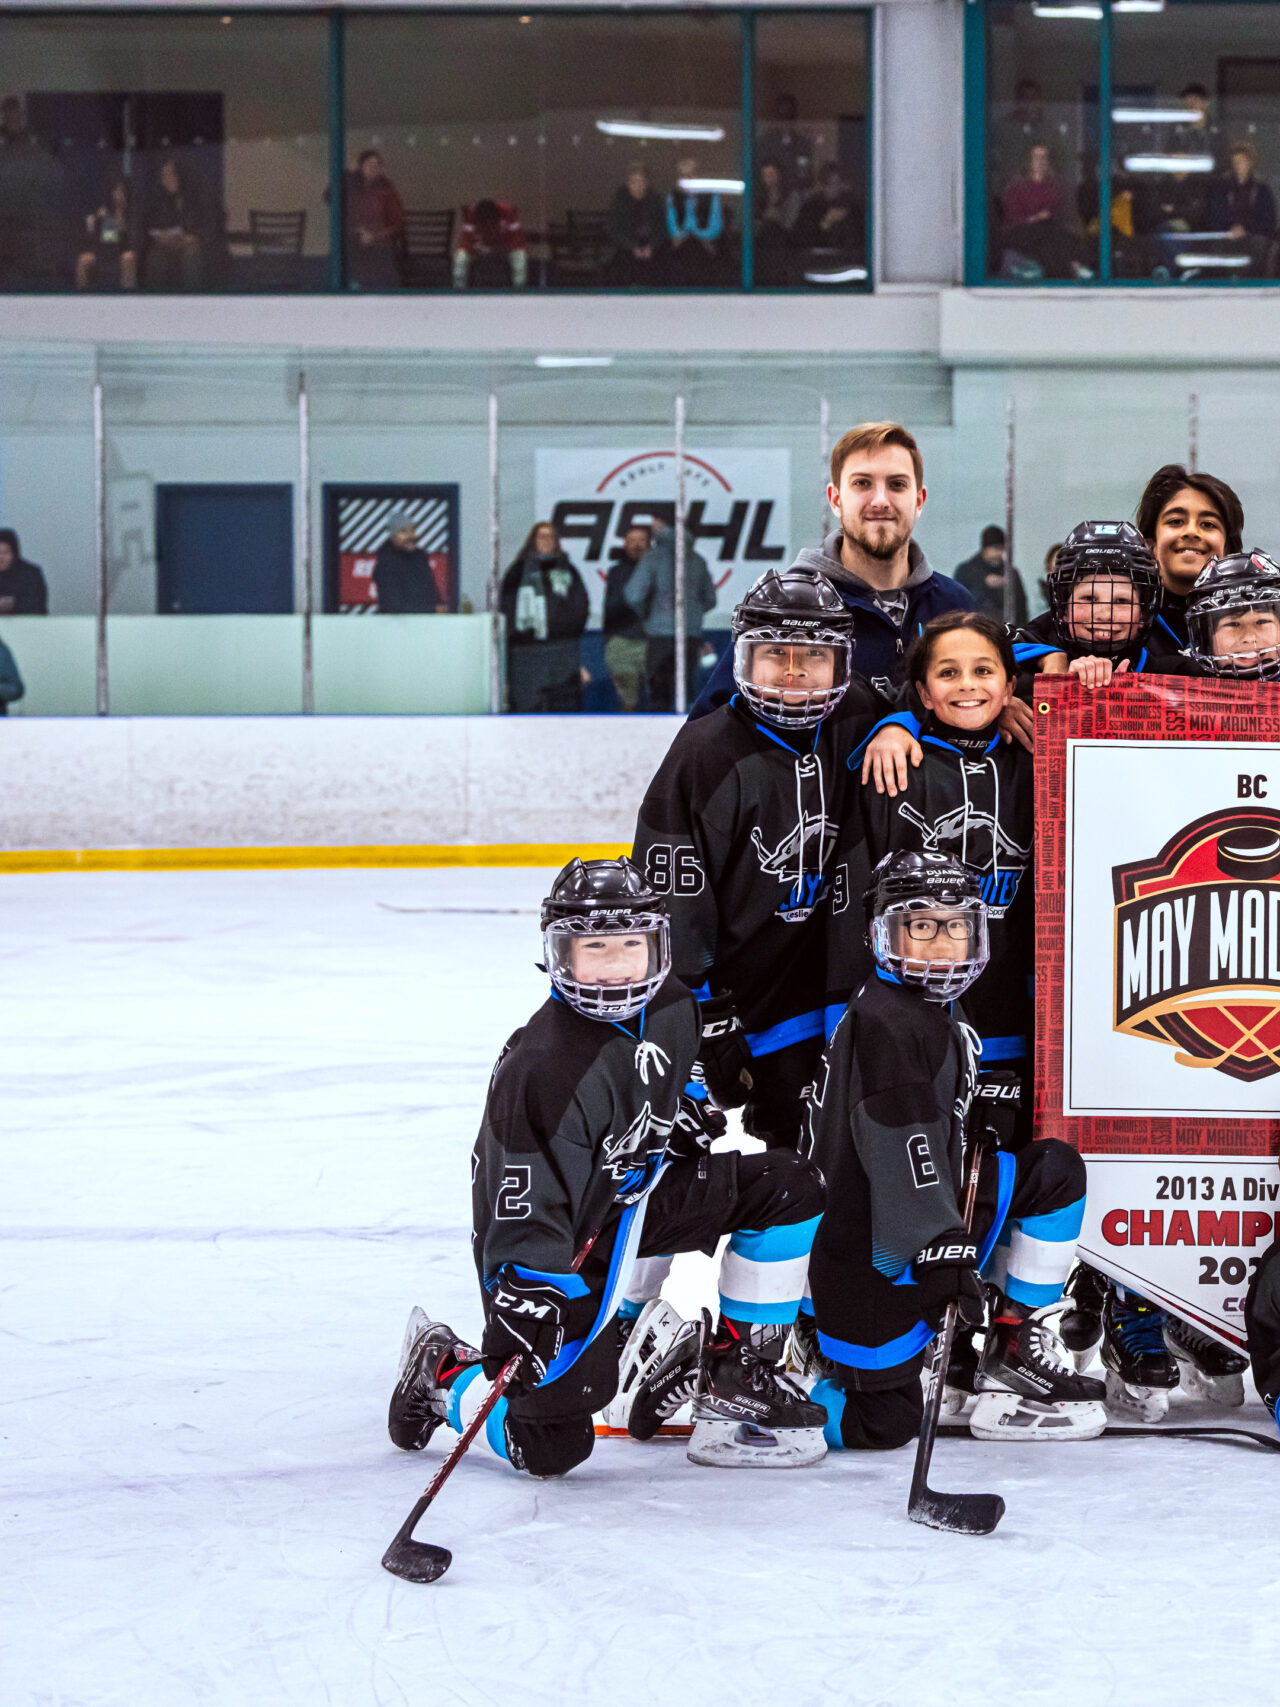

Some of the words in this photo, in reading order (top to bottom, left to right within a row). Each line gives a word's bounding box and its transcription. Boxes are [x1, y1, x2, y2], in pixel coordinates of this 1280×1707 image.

[781, 619, 821, 627] BAUER
[1189, 714, 1216, 731] MAY
[1220, 715, 1280, 732] MADNESS
[1236, 774, 1268, 799] BC
[645, 844, 705, 896] 86
[589, 908, 632, 917] BAUER
[1122, 894, 1197, 1011] MAY
[1176, 1128, 1201, 1146] MAY
[1206, 1128, 1267, 1147] MADNESS
[907, 1134, 940, 1189] 6
[495, 1165, 532, 1219] 2
[1156, 1175, 1215, 1200] 2013
[1220, 1177, 1237, 1201] A
[650, 1364, 682, 1393] BAUER
[1017, 1365, 1054, 1390] BAUER
[735, 1396, 769, 1412] BAUER
